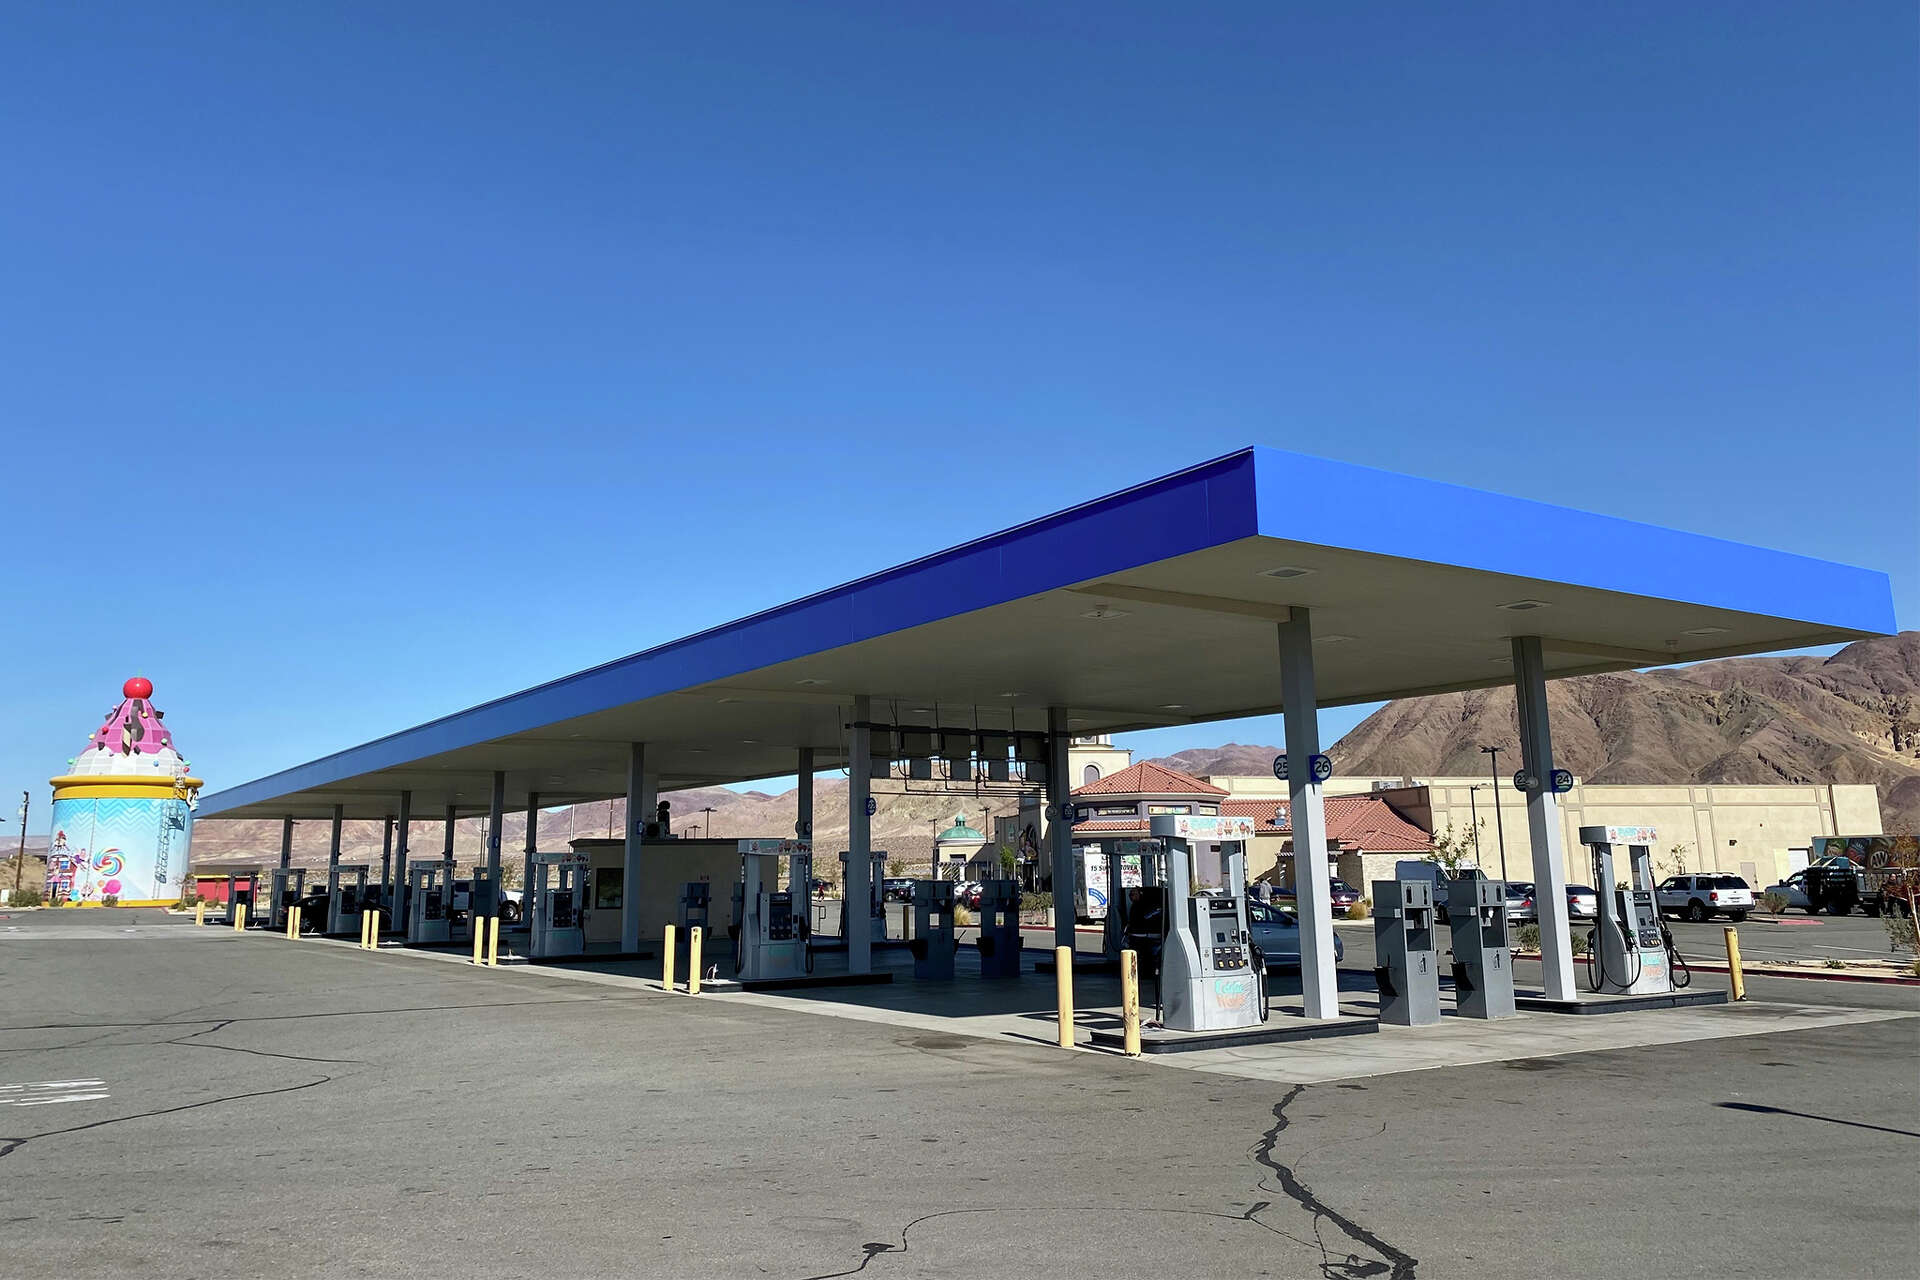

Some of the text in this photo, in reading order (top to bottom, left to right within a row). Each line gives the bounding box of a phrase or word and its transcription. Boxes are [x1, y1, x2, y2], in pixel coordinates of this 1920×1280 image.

[1276, 761, 1288, 774] 25
[1315, 760, 1329, 773] 26
[1556, 774, 1570, 784] 24
